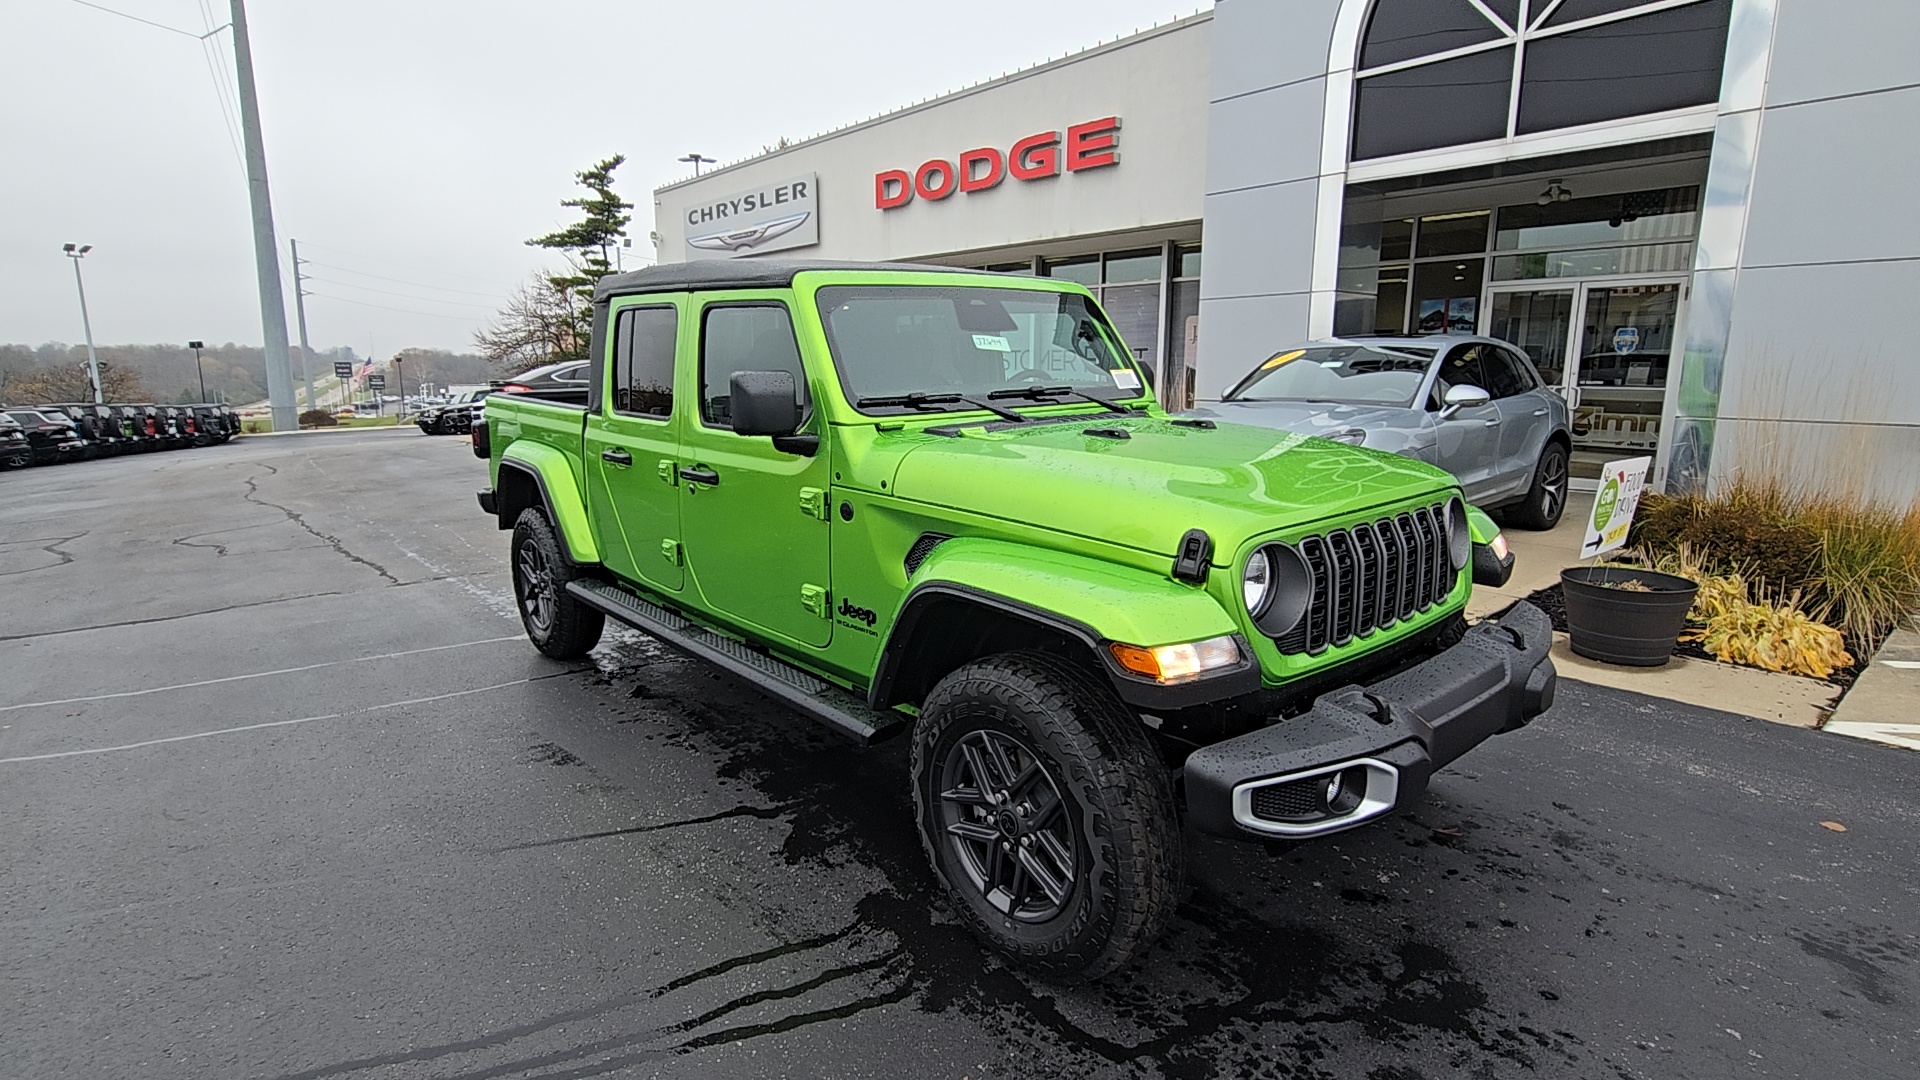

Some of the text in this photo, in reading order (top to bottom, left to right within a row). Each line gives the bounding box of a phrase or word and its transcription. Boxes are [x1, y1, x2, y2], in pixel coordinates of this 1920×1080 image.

[875, 116, 1122, 211] DODGE
[688, 182, 807, 225] CHRYSLER
[838, 597, 877, 627] Jeep
